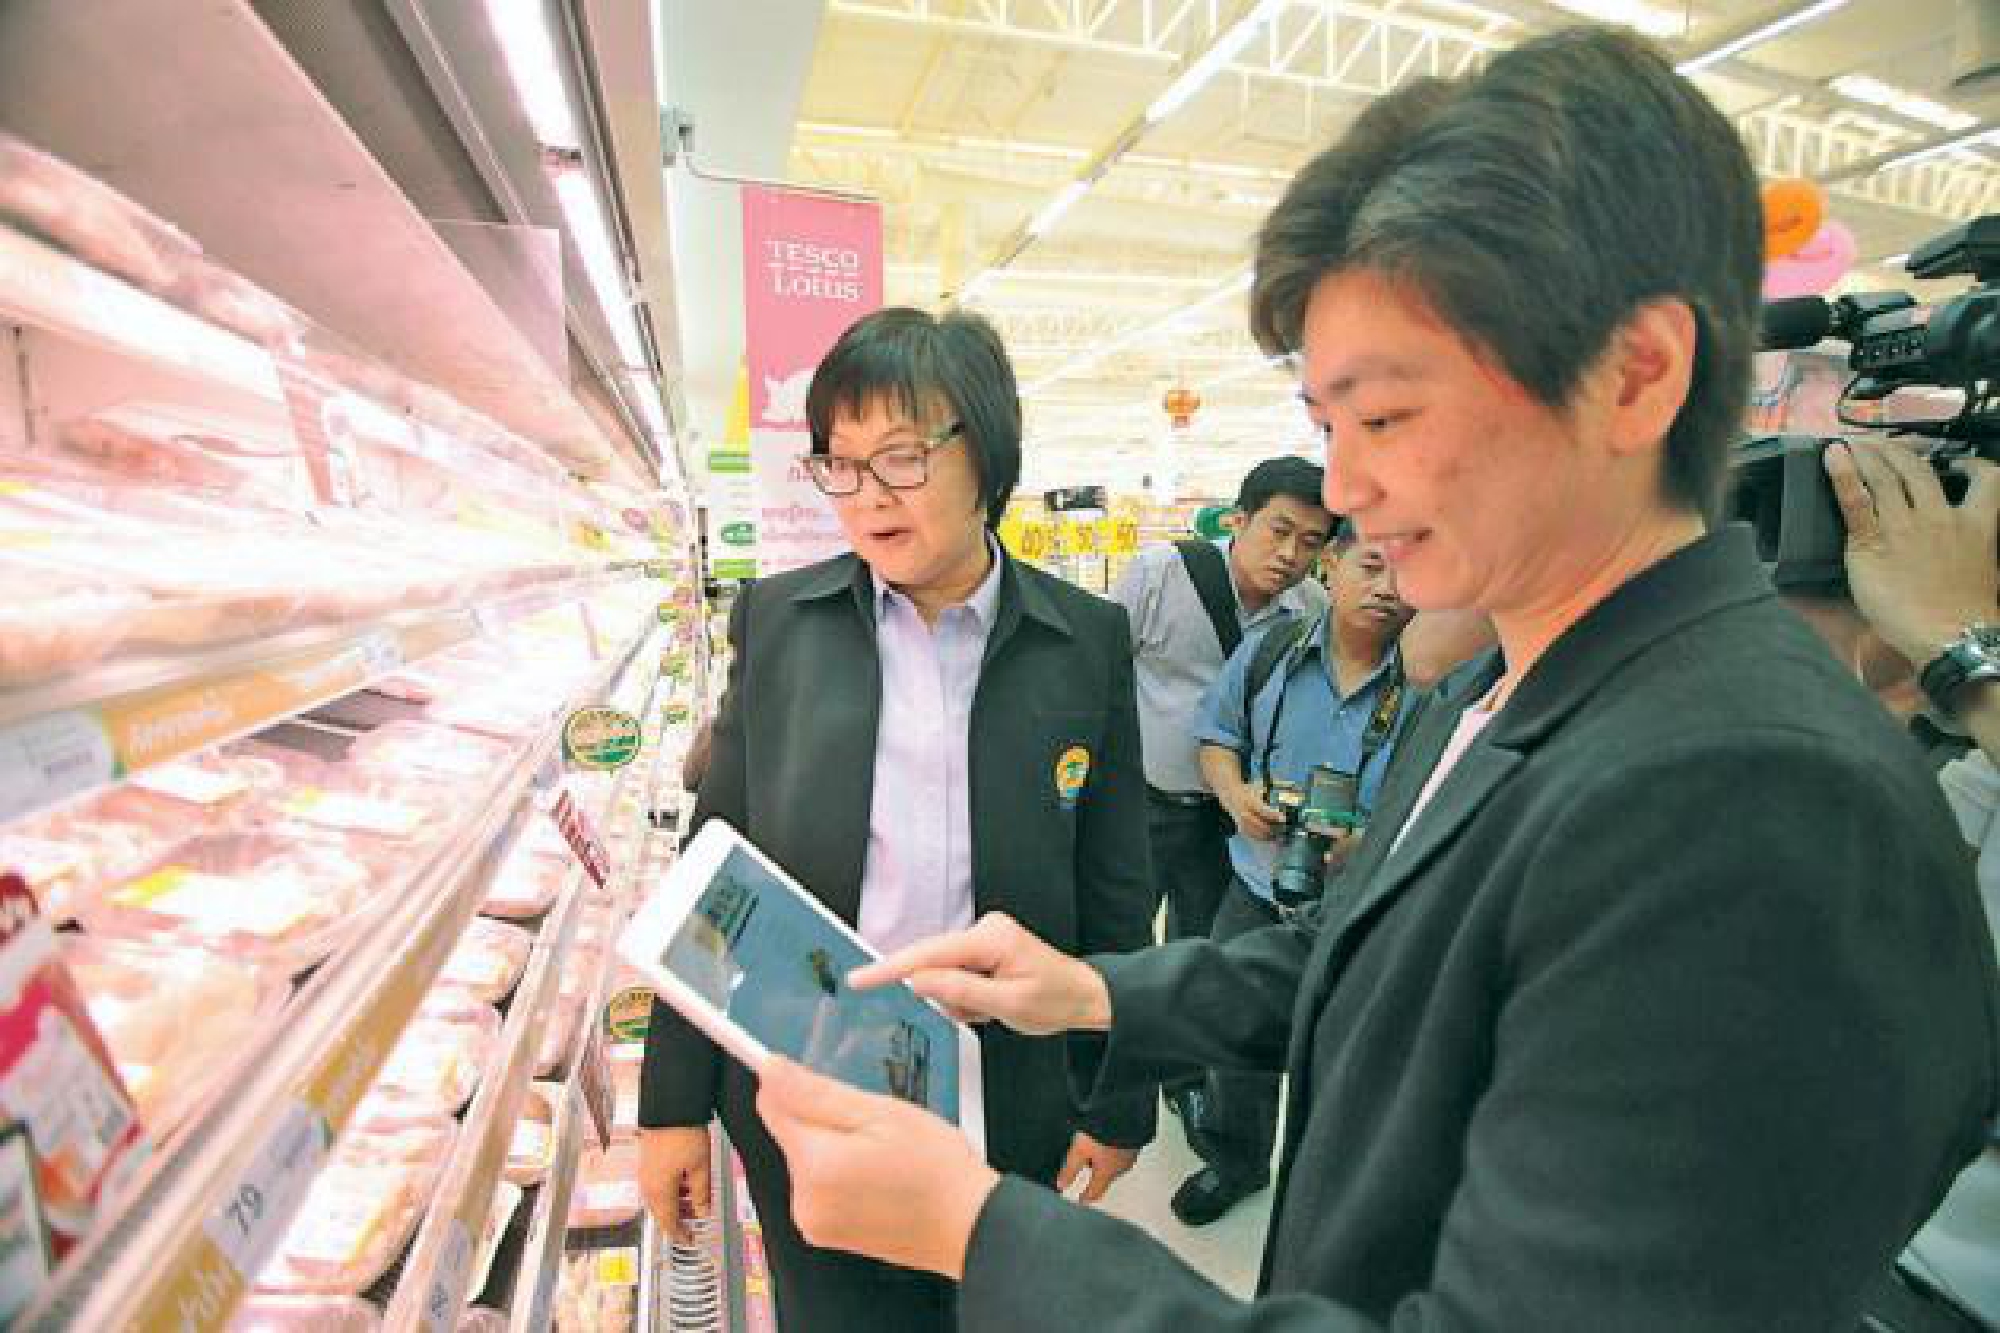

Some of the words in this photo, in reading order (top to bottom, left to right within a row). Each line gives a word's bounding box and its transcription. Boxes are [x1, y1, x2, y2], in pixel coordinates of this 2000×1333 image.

[764, 240, 859, 268] TESCO
[770, 270, 862, 303] Lotus
[224, 1184, 264, 1237] 79
